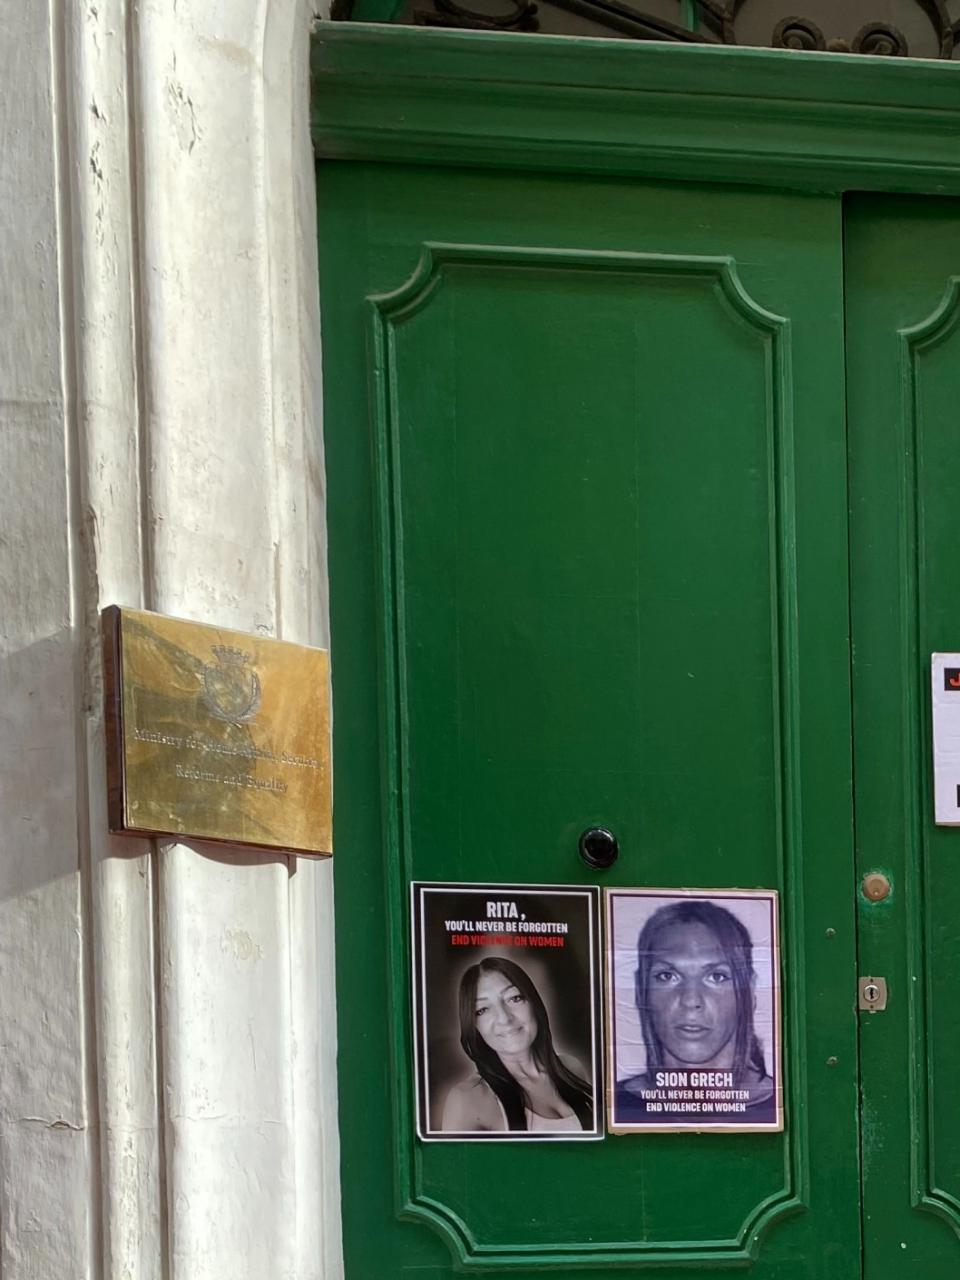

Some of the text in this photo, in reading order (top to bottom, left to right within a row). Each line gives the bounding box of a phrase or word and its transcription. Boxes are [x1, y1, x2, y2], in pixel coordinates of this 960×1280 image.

[444, 920, 569, 934] YOU'LL NEVER BE FORGOTTEN
[451, 934, 470, 946] END
[514, 935, 528, 946] ON
[528, 936, 565, 947] WOMEN
[655, 1071, 733, 1087] SION GRECH
[640, 1089, 750, 1100] YOU'LL NEVER BE FORGOTTEN
[646, 1102, 746, 1113] END VIOLENCE ON WOMEN
